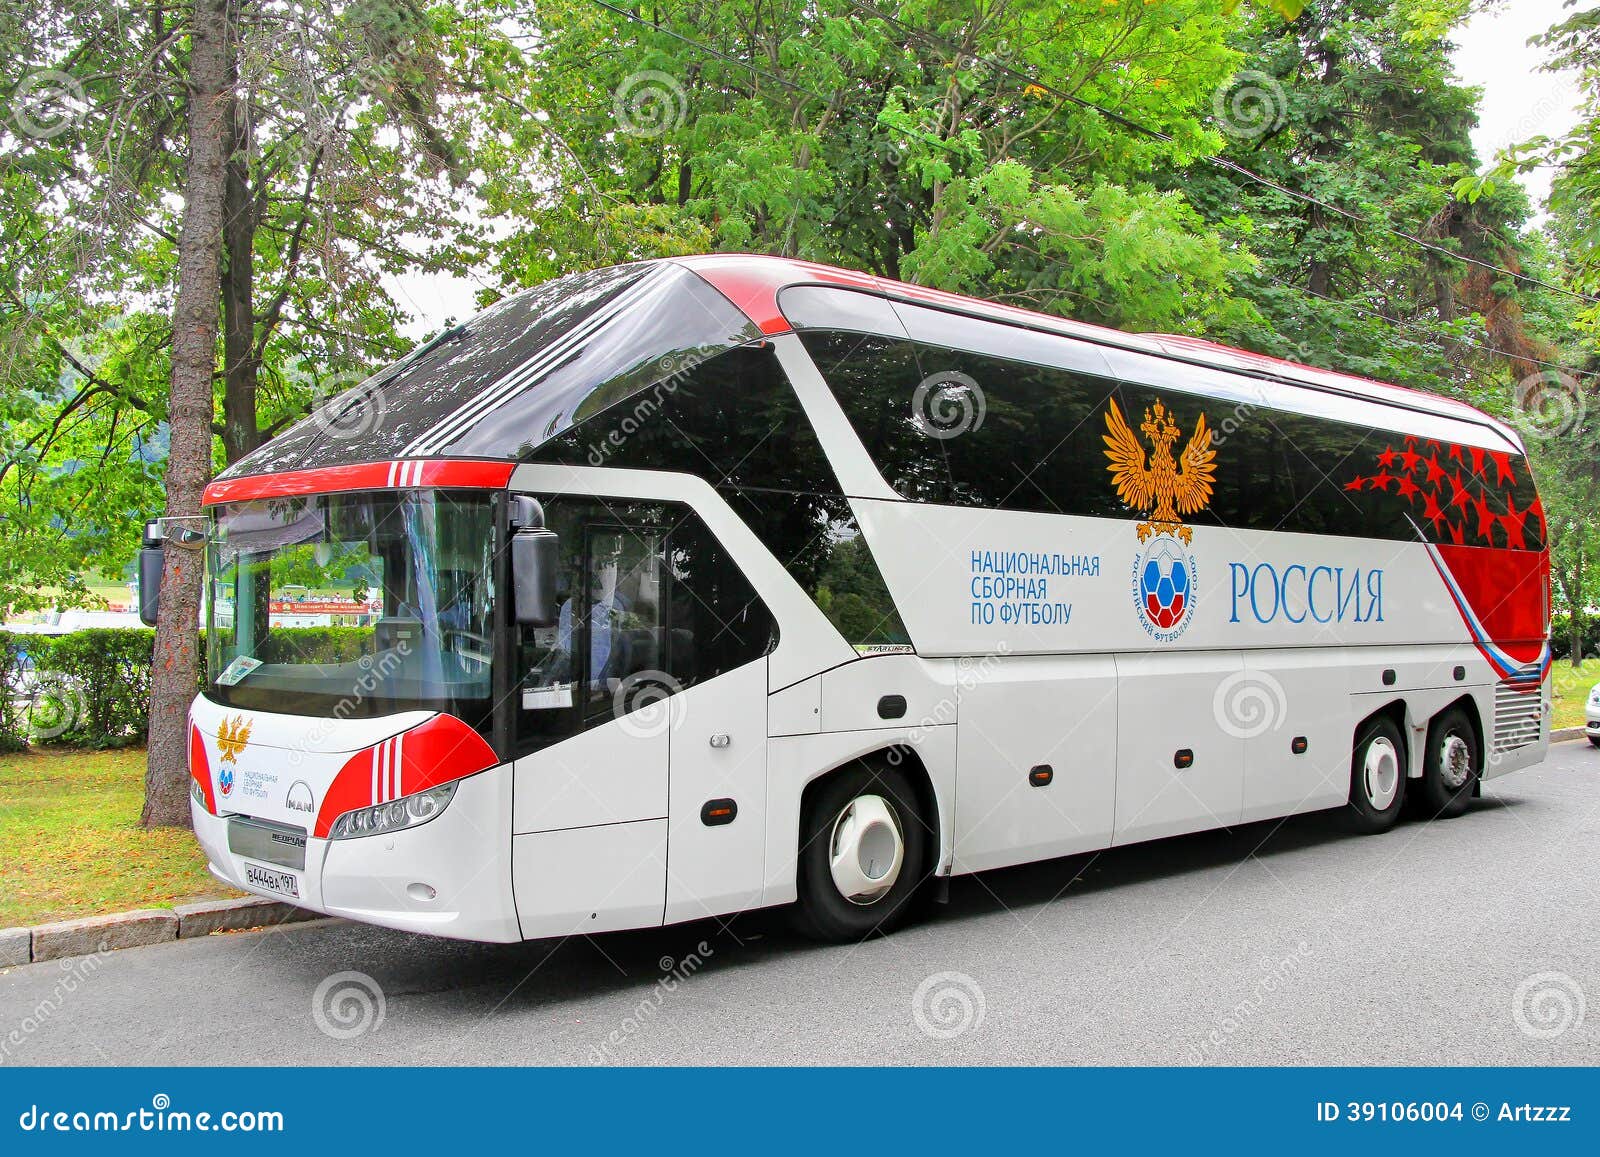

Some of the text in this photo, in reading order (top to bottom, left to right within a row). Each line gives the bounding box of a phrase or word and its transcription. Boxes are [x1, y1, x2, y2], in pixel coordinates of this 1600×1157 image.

[971, 550, 1100, 578] НАЦИОНАЛЬНАЯ
[971, 577, 1047, 599] СБОРНАЯ
[1229, 562, 1384, 624] РОССИЯ
[971, 602, 1072, 625] ПО ФУТБОЛУ
[288, 799, 312, 813] MAN
[272, 833, 306, 846] NEOPLAN
